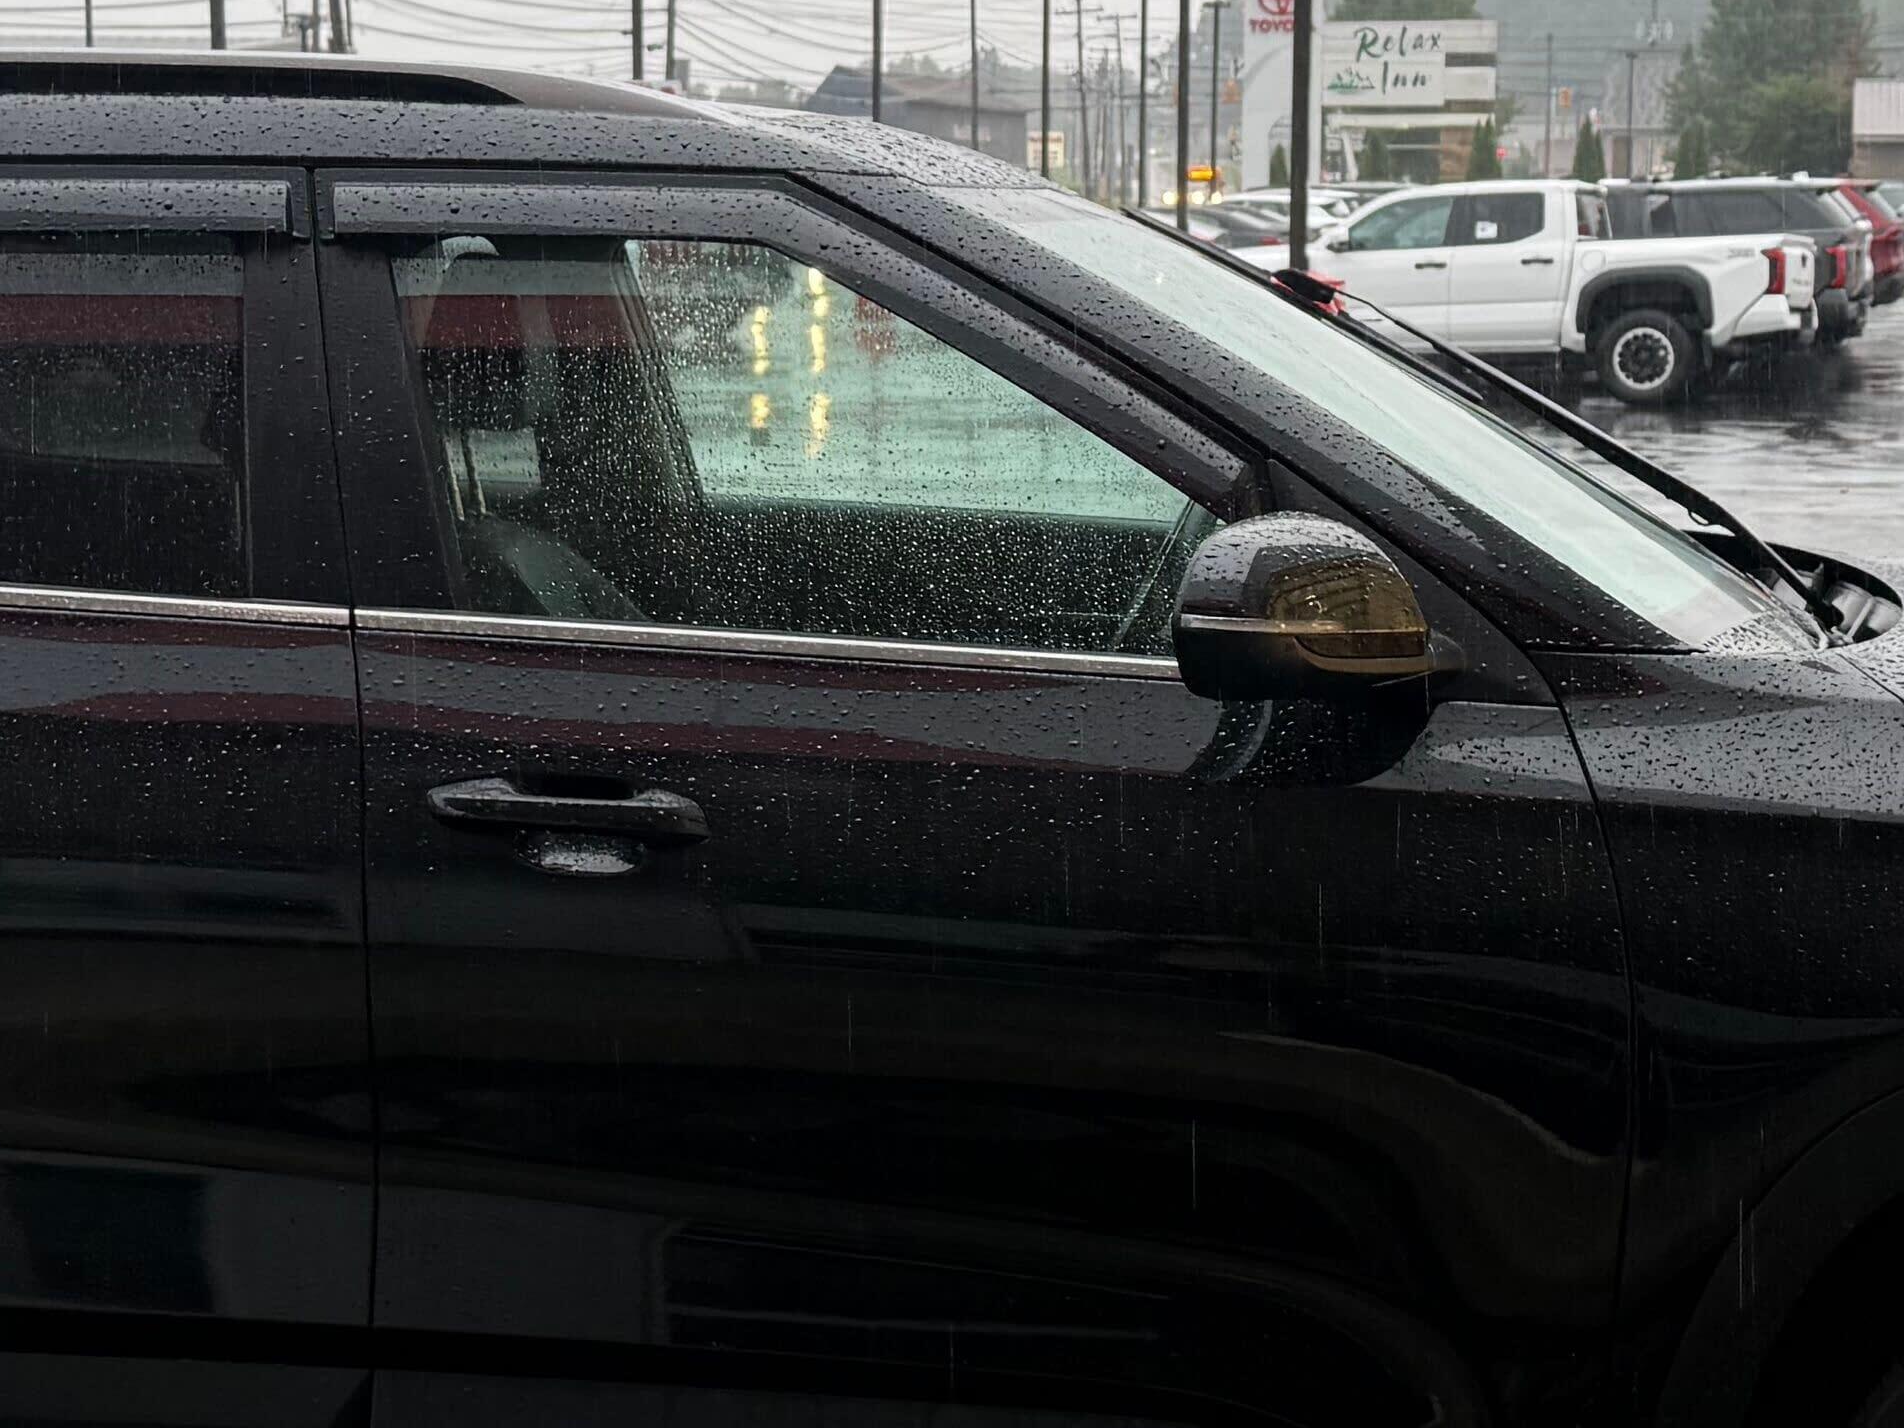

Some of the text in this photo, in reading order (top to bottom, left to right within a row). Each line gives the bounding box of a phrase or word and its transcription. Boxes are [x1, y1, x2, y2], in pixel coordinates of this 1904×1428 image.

[1249, 19, 1294, 34] TOYO
[1353, 25, 1441, 62] Relax
[1381, 61, 1427, 95] Inn
